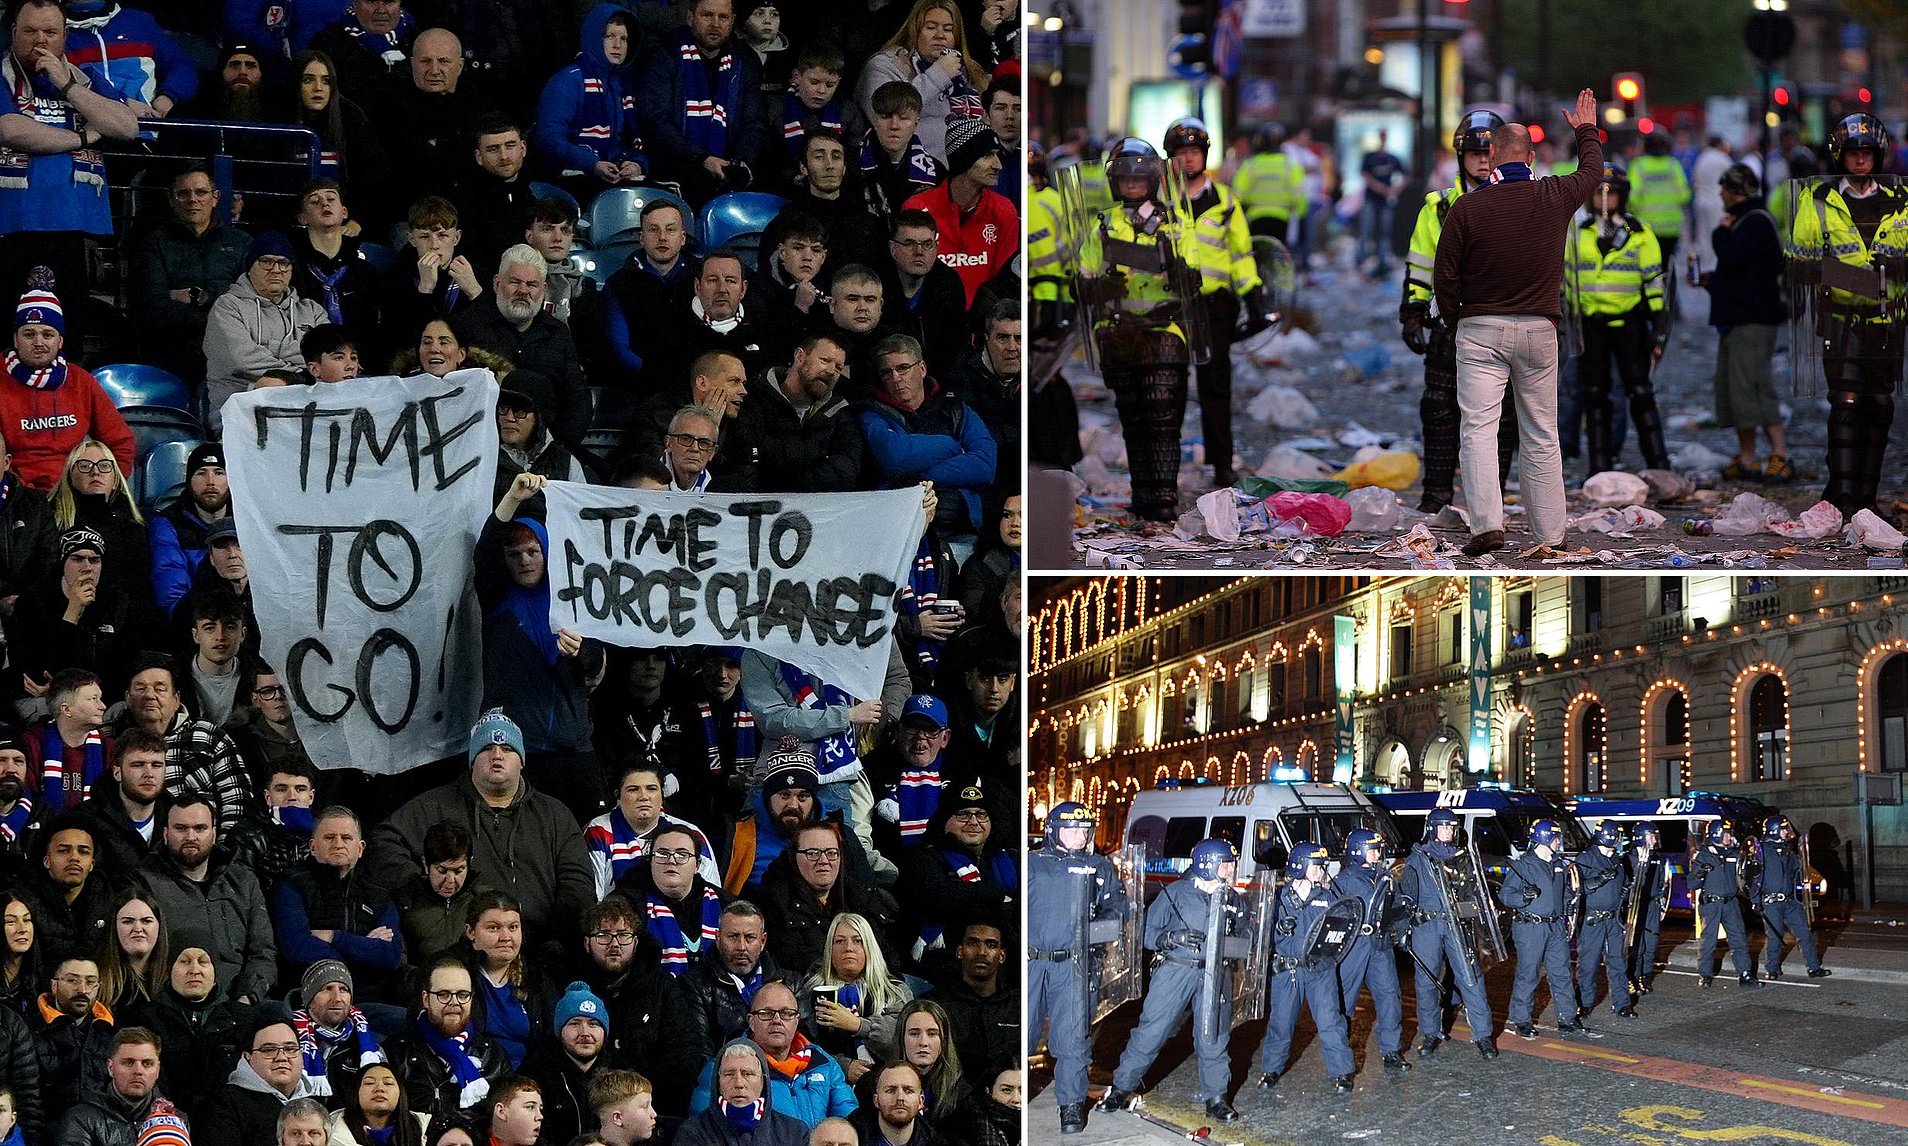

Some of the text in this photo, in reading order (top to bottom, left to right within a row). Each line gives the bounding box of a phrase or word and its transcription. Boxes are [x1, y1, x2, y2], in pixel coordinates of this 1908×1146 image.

[32, 97, 66, 109] UNIBE
[21, 415, 77, 430] RANGERS
[254, 386, 484, 494] TIME
[579, 500, 813, 573] TIME TO
[277, 519, 422, 631] TO
[557, 538, 702, 638] FORCE
[1219, 785, 1257, 806] XZ06
[1656, 798, 1696, 814] XZ09
[1143, 858, 1177, 872] ACTICAL
